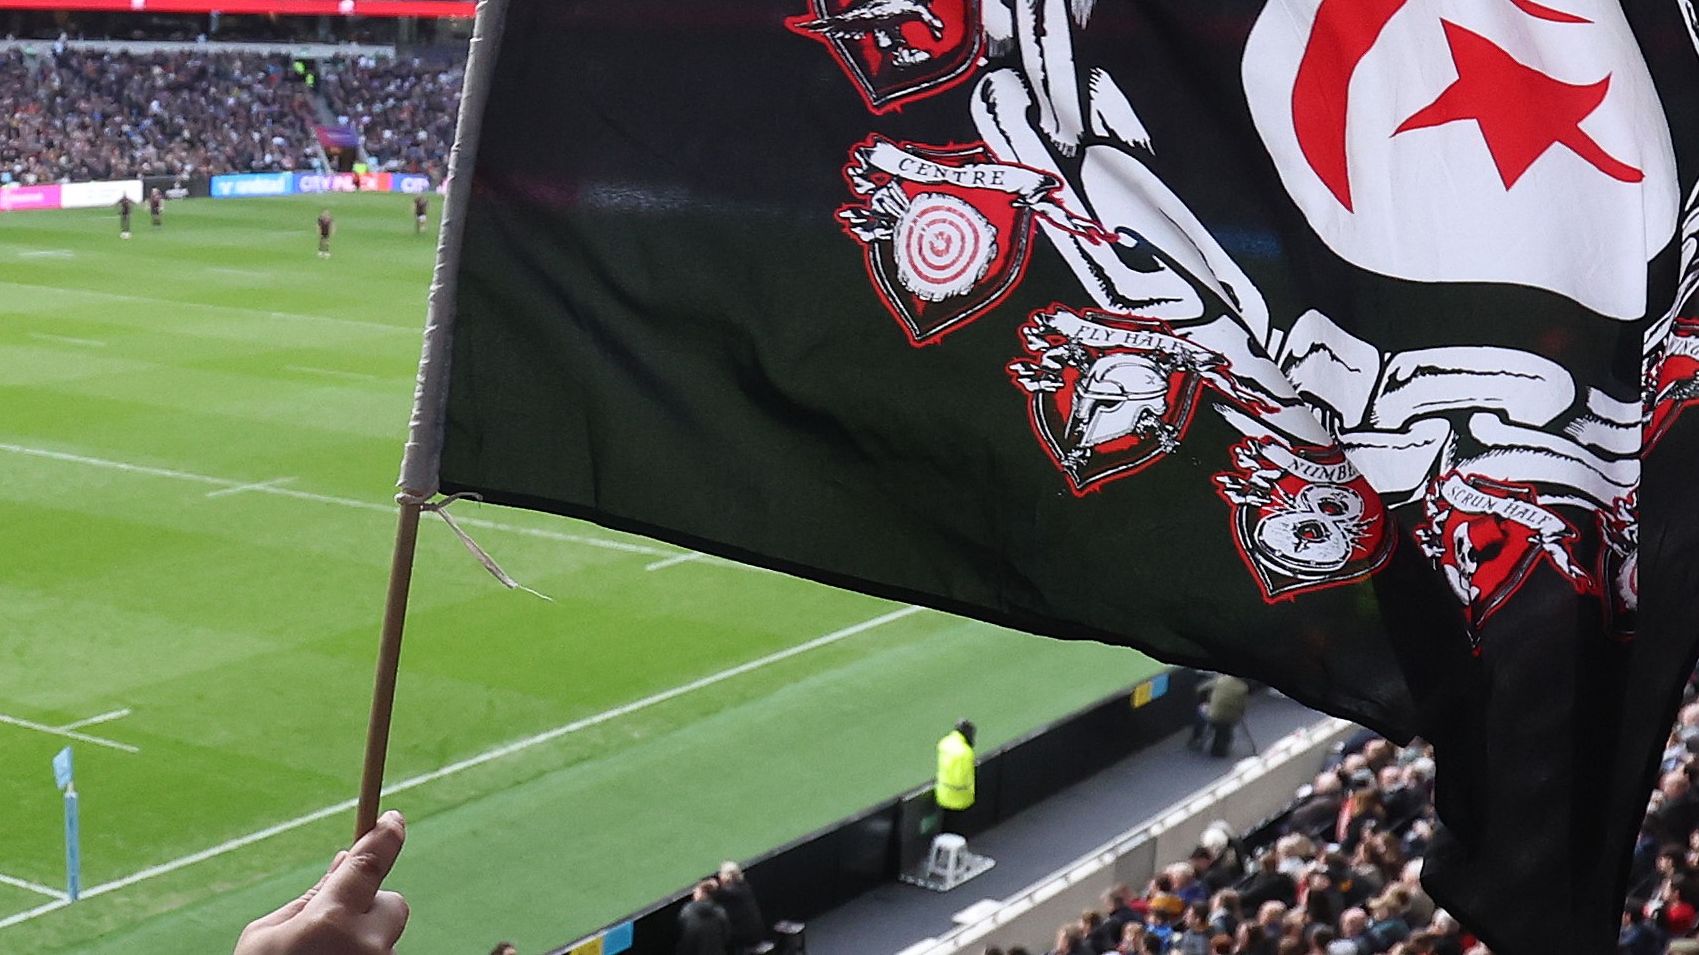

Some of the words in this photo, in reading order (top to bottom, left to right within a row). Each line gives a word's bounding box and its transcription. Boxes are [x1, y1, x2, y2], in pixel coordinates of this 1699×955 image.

[898, 157, 1005, 186] CENTRE
[1075, 325, 1114, 343] FLY
[1450, 486, 1497, 511] SCRUM
[1503, 502, 1552, 524] HALF
